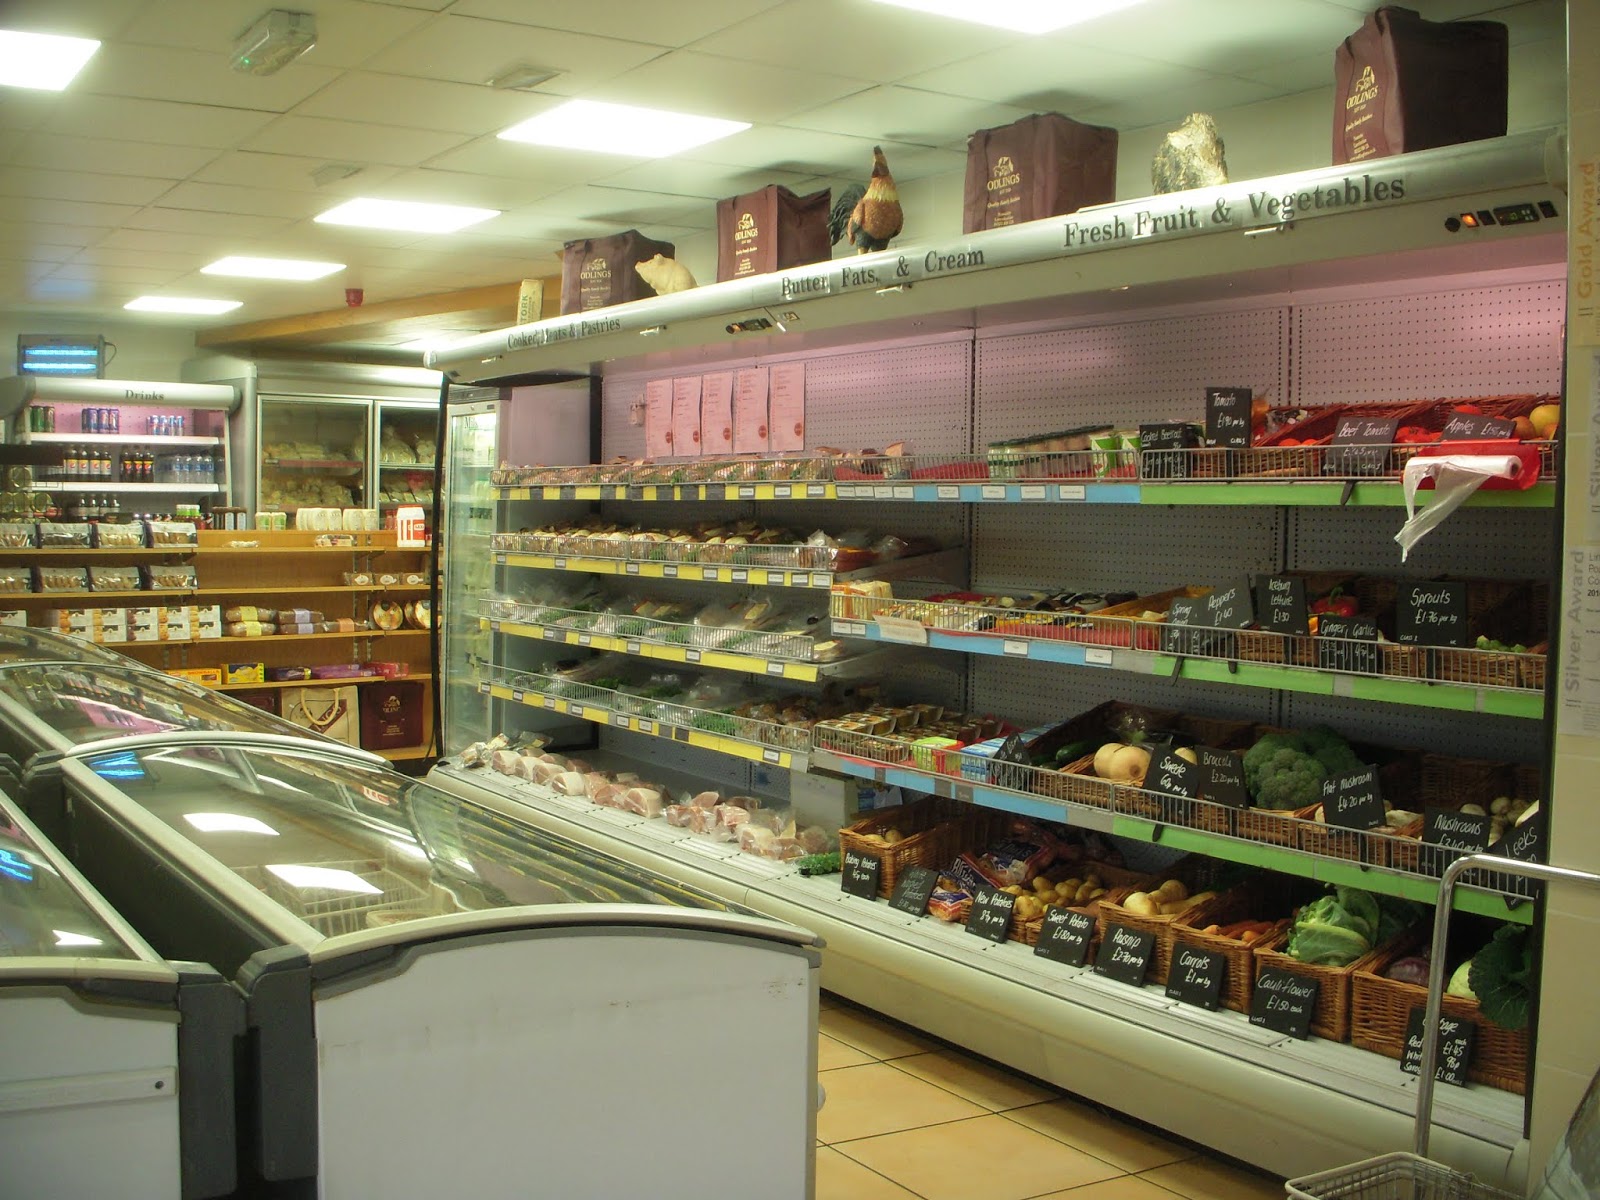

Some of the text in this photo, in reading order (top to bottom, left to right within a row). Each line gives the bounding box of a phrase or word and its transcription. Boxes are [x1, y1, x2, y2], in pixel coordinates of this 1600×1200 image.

[1346, 85, 1379, 110] ODLINGS
[987, 173, 1020, 191] ODLINGS
[1064, 174, 1406, 247] Fresh Fruit & Vegetables
[1577, 162, 1595, 299] Gold Award
[896, 255, 910, 278] &
[924, 249, 985, 273] Cream
[580, 270, 612, 280] ODLINGS
[581, 317, 621, 337] Pastries
[125, 389, 165, 401] Drinks
[1213, 392, 1236, 407] Tomato
[1338, 422, 1390, 438] Beef Tomato
[1445, 417, 1475, 434] Apples
[1208, 588, 1236, 611] Peppers
[1271, 594, 1293, 606] Lettuce
[1410, 588, 1451, 607] Sprouts
[1172, 603, 1192, 619] Spring
[1437, 615, 1448, 626] per
[1450, 614, 1458, 624] kg
[1353, 623, 1375, 639] Garlic
[1565, 551, 1584, 692] Silver Award
[1160, 756, 1186, 779] Swede
[1323, 772, 1373, 797] Flat Mushroom
[1434, 814, 1483, 835] Mushrooms
[975, 890, 1013, 909] New Potatoes
[1048, 909, 1089, 929] Sweet Potato
[1180, 950, 1211, 970] Carrots
[1185, 968, 1197, 983] £1
[1257, 973, 1314, 998] Cauliflower
[1290, 1005, 1303, 1014] each
[1408, 1035, 1424, 1048] Red
